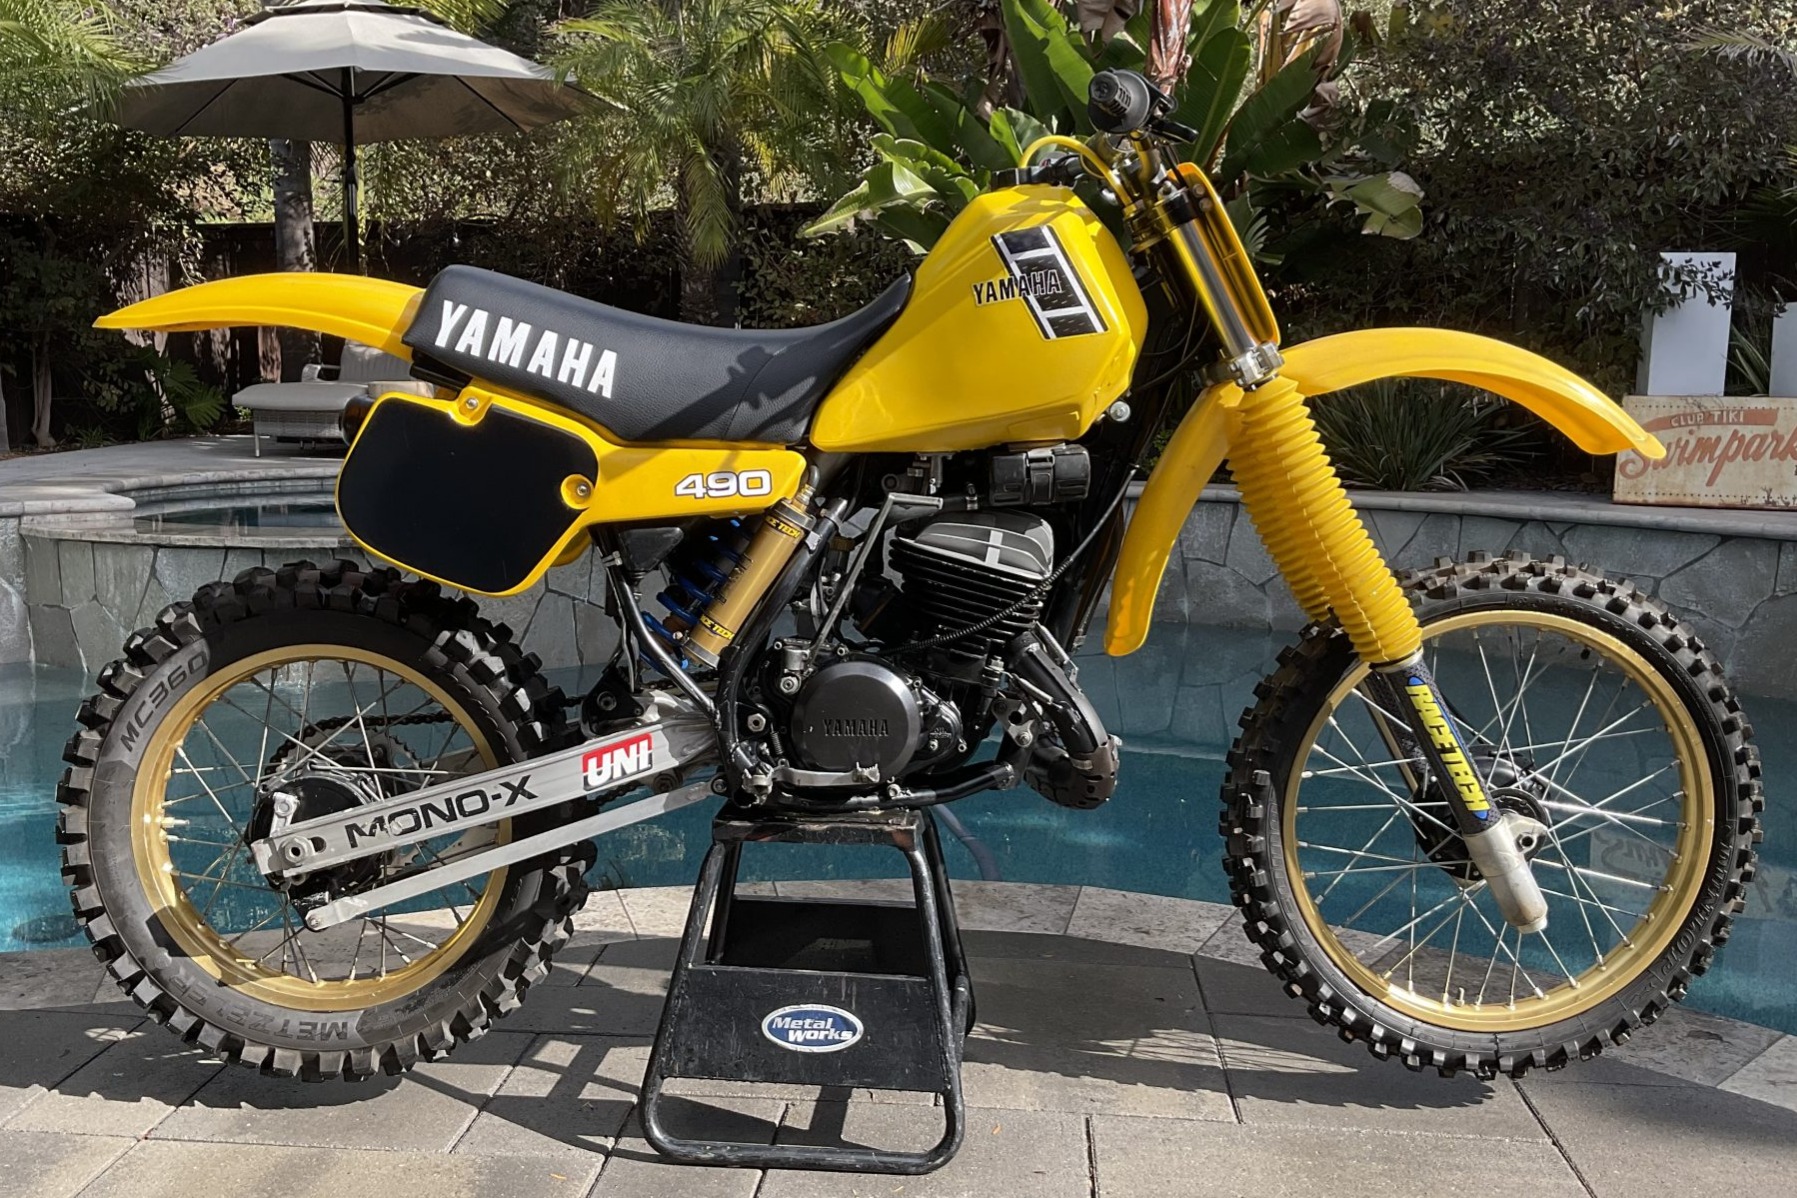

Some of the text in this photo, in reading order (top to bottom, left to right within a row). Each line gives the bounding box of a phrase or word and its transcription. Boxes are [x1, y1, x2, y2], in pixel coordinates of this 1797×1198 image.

[972, 269, 1064, 307] YAMAHA
[435, 300, 617, 399] YAMAHA
[1671, 410, 1745, 427] CLUB TIKI
[675, 469, 772, 499] 490
[778, 521, 800, 538] TECH
[120, 651, 208, 753] MC360
[823, 718, 889, 737] YAMAHA
[587, 740, 651, 787] UNI
[1405, 684, 1491, 811] RACE TECH
[344, 775, 539, 848] MONO-X
[772, 1017, 833, 1029] Metal
[788, 1028, 853, 1042] Works
